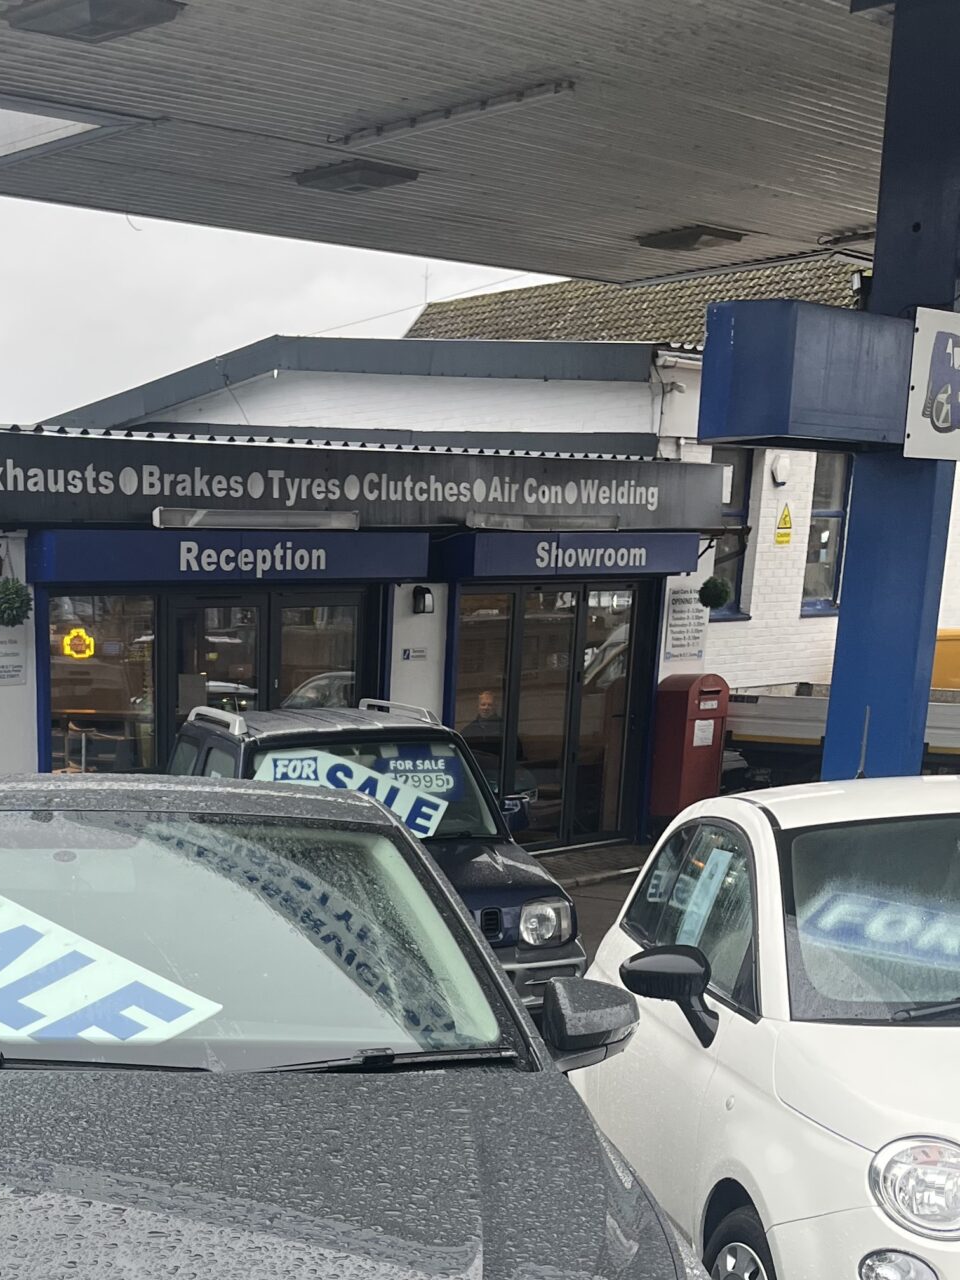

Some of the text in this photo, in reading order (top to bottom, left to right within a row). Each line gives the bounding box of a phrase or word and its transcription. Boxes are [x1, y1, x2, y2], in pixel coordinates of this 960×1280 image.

[142, 465, 244, 499] Brakes
[268, 469, 340, 507] Tyres
[363, 472, 471, 502] Clutches
[488, 476, 519, 503] Air
[523, 478, 563, 504] Con
[580, 479, 659, 511] Welding
[180, 541, 326, 578] Reception
[536, 542, 646, 568] Showroom
[275, 759, 316, 780] FOR
[390, 759, 445, 770] FOR SALE
